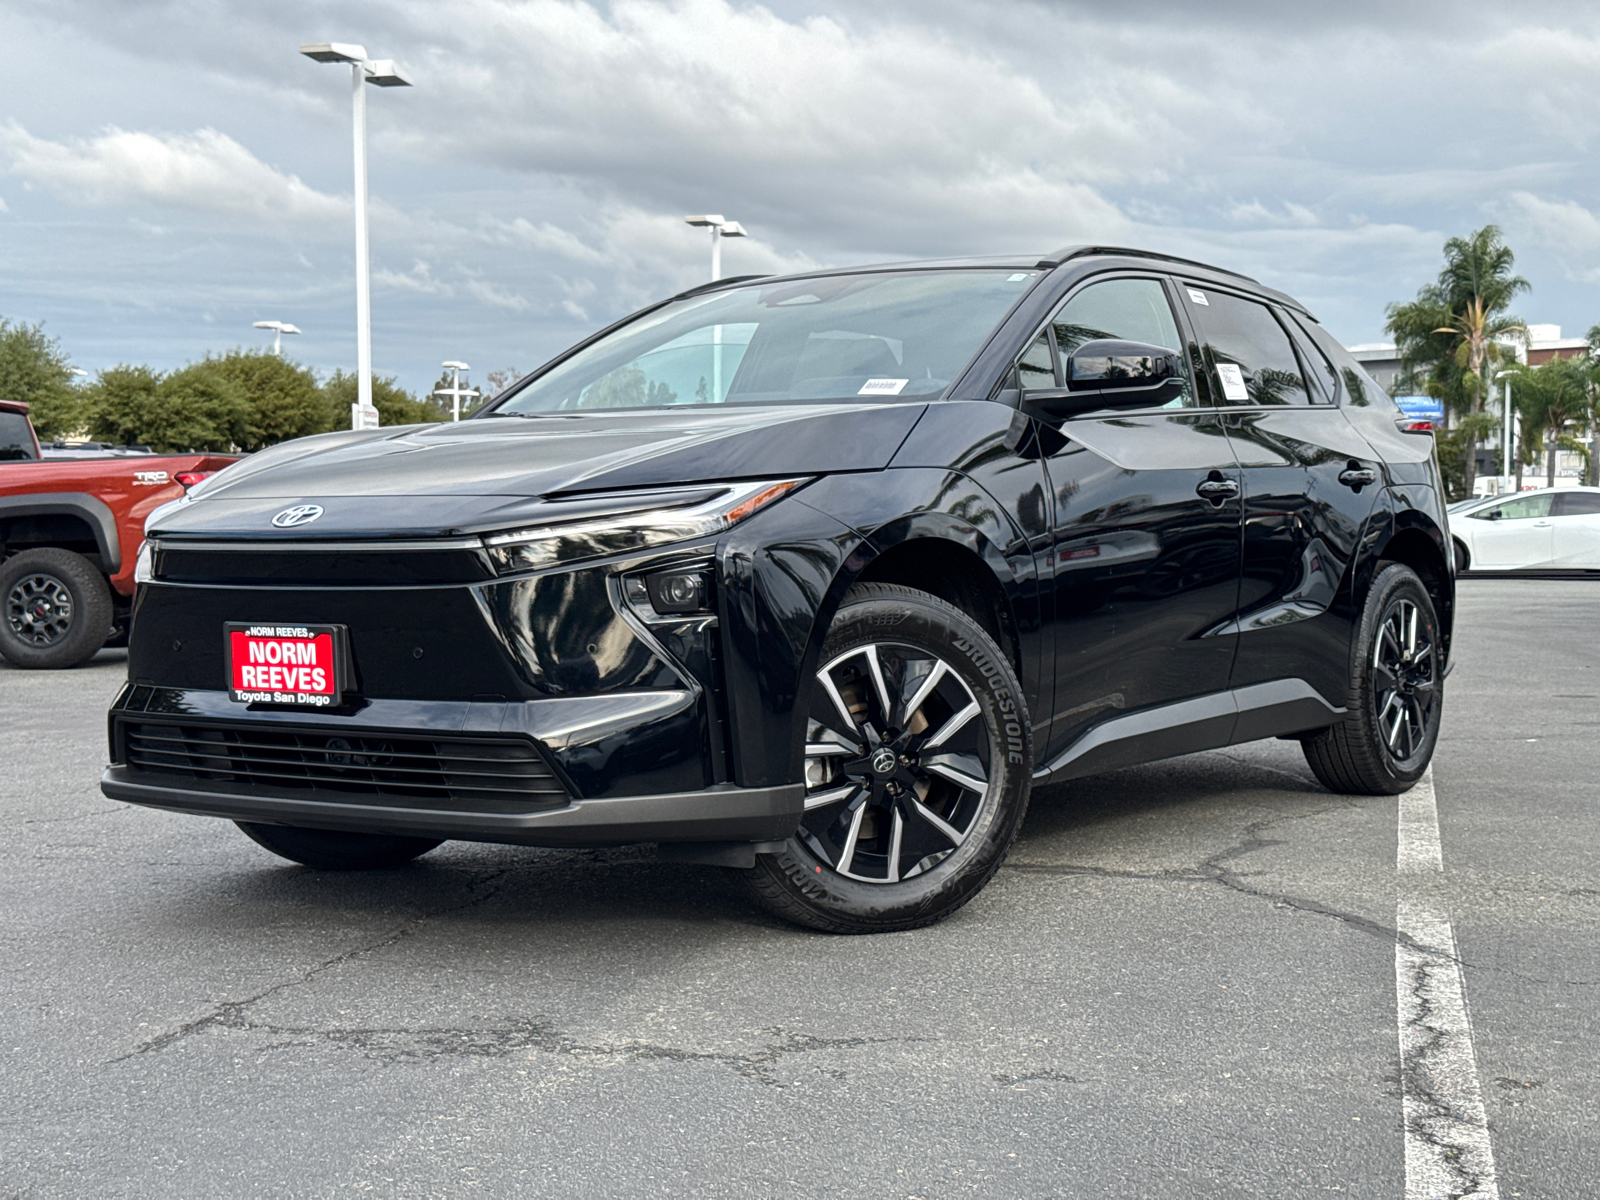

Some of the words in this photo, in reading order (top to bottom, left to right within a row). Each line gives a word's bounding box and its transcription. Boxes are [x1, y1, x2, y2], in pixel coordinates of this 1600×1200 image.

[133, 471, 167, 481] TRD
[250, 626, 275, 637] NORM
[276, 627, 308, 638] REEVES
[249, 641, 316, 665] NORM
[241, 665, 326, 691] REEVES
[234, 690, 271, 702] Toyota
[273, 691, 295, 703] San
[297, 693, 330, 706] Diego
[952, 636, 1024, 765] BRIDGESTONE
